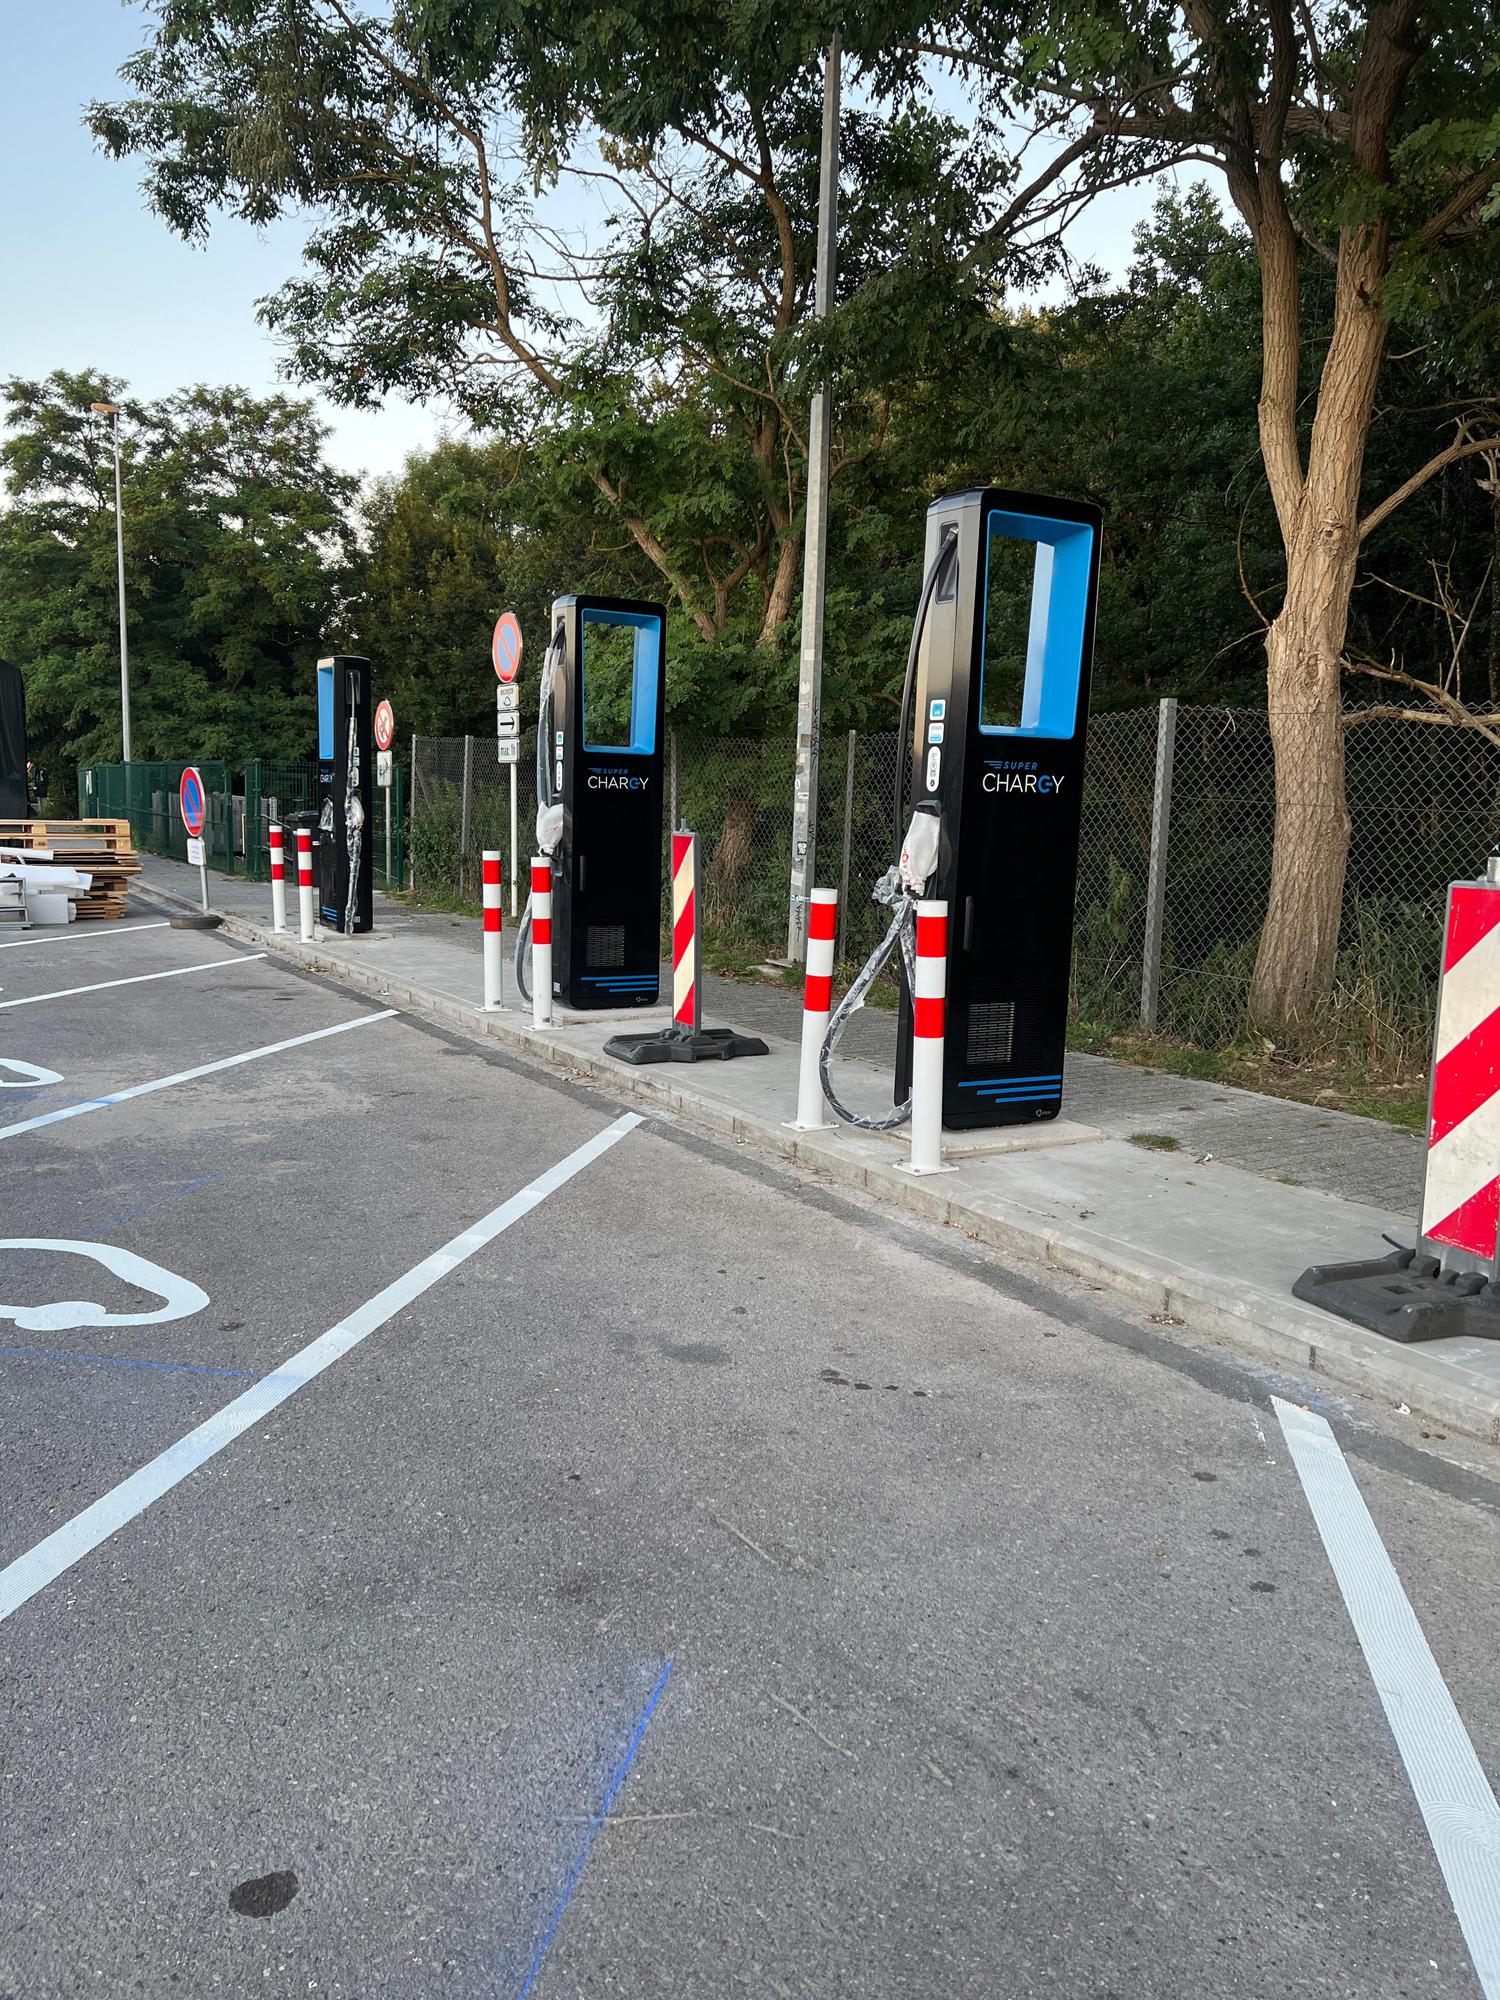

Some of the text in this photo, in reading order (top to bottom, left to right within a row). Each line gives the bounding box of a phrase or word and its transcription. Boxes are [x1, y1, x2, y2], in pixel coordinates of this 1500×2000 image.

[1003, 761, 1038, 770] SUPER
[587, 775, 649, 790] CHARGY
[982, 773, 1065, 794] CHARGY
